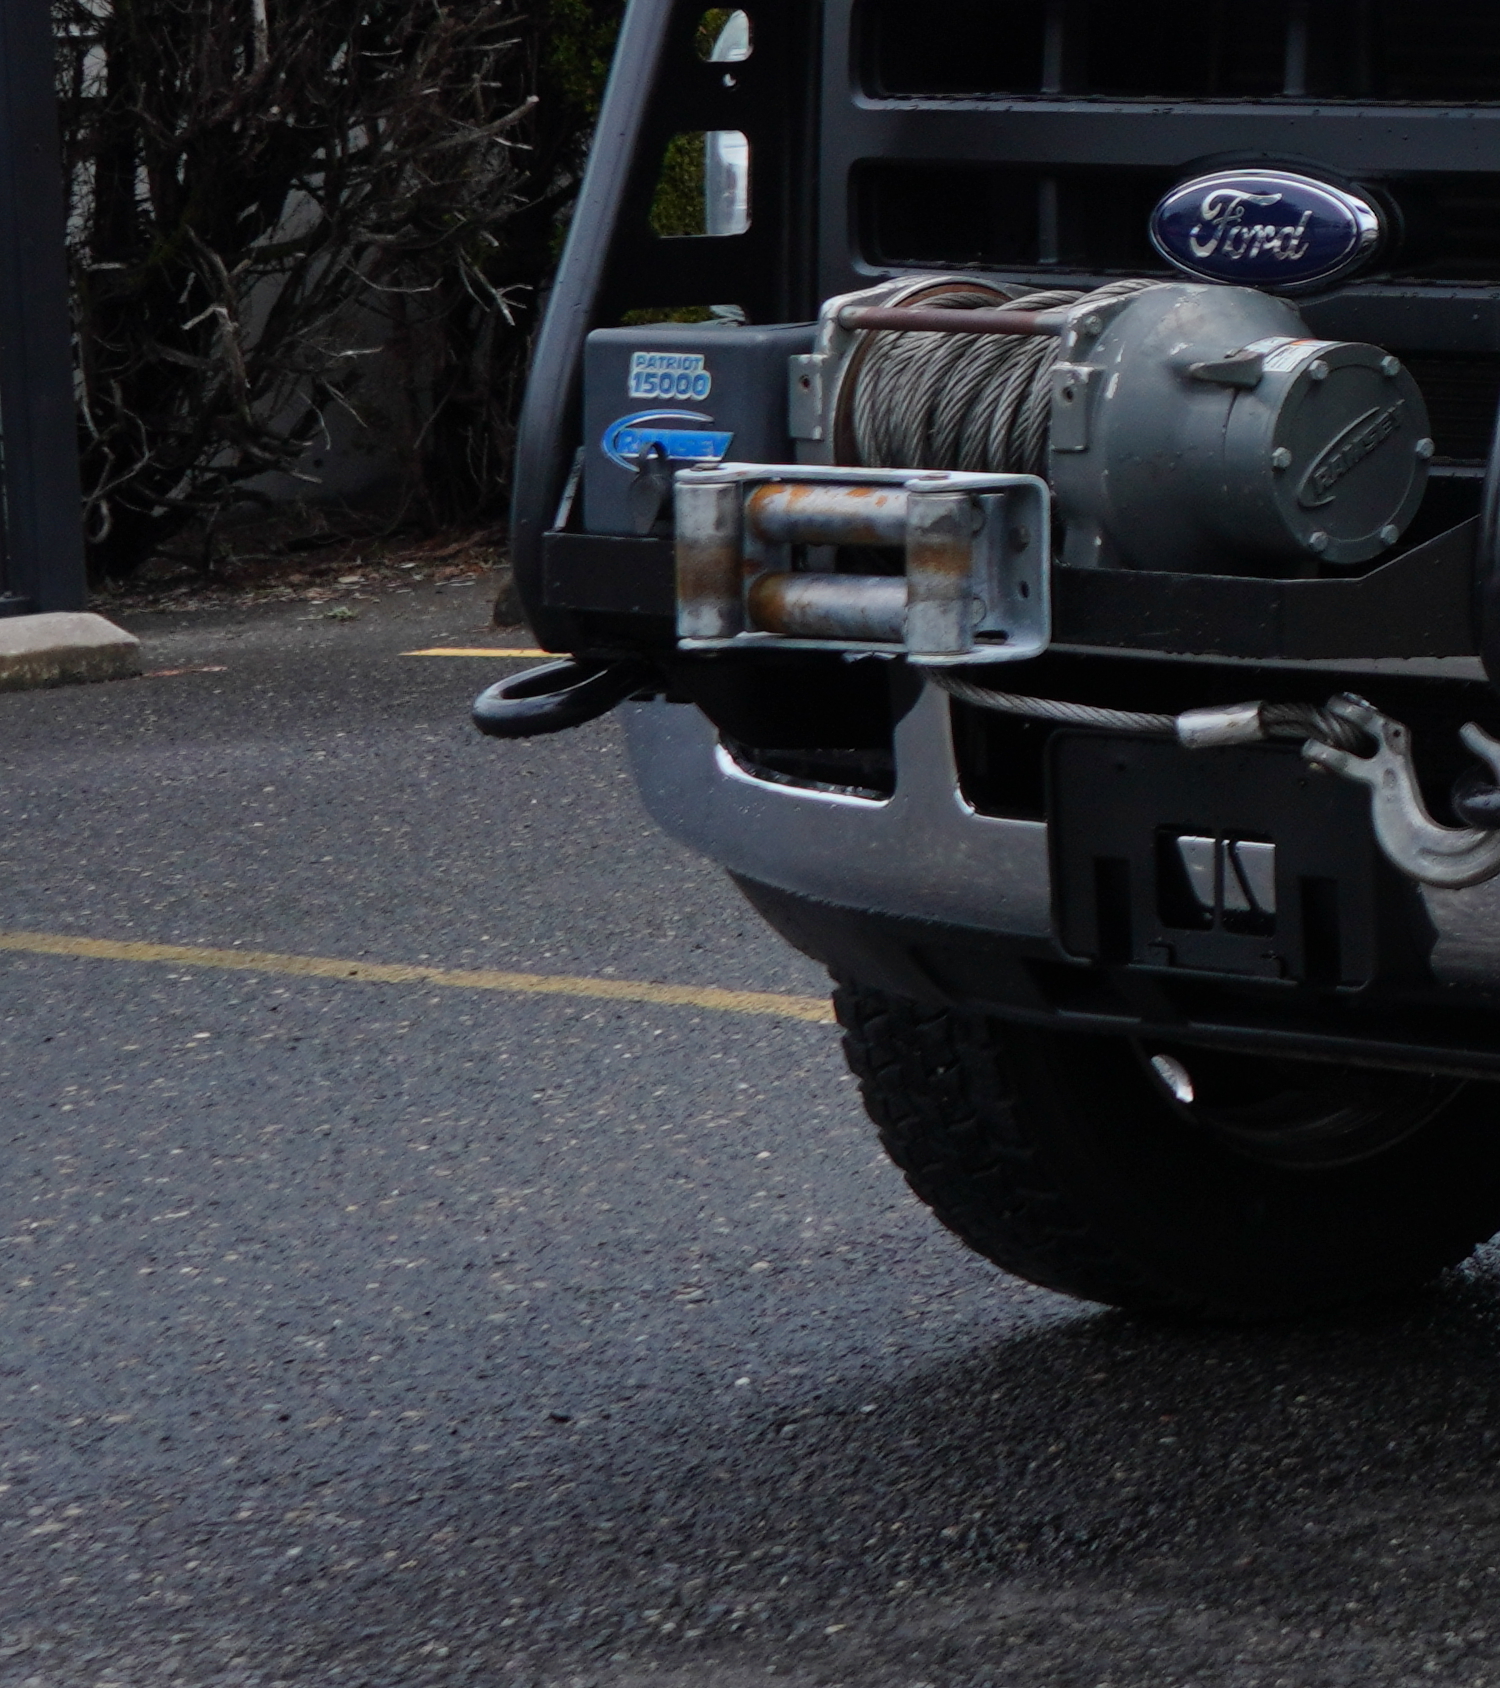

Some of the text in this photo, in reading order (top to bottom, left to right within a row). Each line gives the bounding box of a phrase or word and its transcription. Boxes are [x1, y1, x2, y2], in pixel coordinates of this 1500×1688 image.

[1190, 188, 1313, 260] Ford
[632, 372, 706, 396] 15000
[635, 354, 703, 370] PATRIOT
[1313, 398, 1406, 497] RAMSEY
